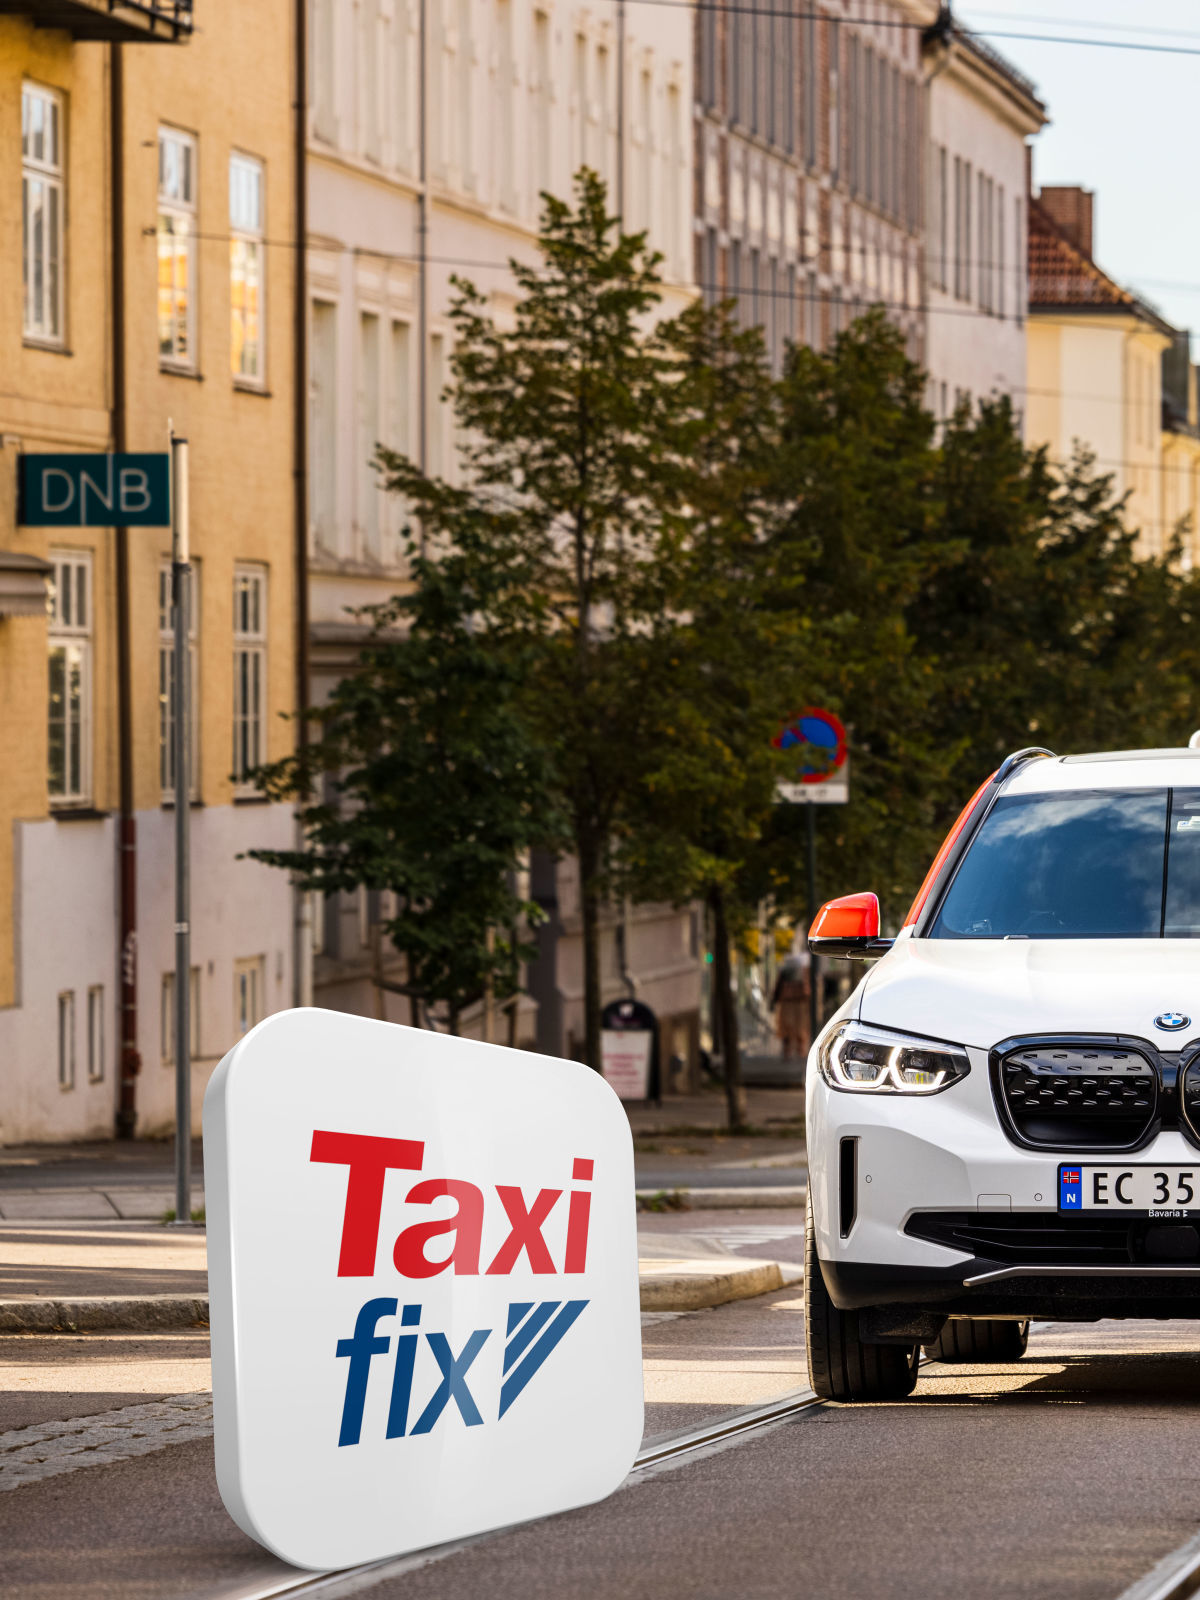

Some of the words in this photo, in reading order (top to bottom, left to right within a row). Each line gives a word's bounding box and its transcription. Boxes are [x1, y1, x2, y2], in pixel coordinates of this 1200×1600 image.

[41, 454, 151, 526] DNB
[310, 1130, 594, 1279] Taxi
[1066, 1193, 1076, 1203] N
[1093, 1172, 1133, 1204] EC
[1148, 1209, 1181, 1218] Bavaria
[335, 1297, 493, 1447] fix
